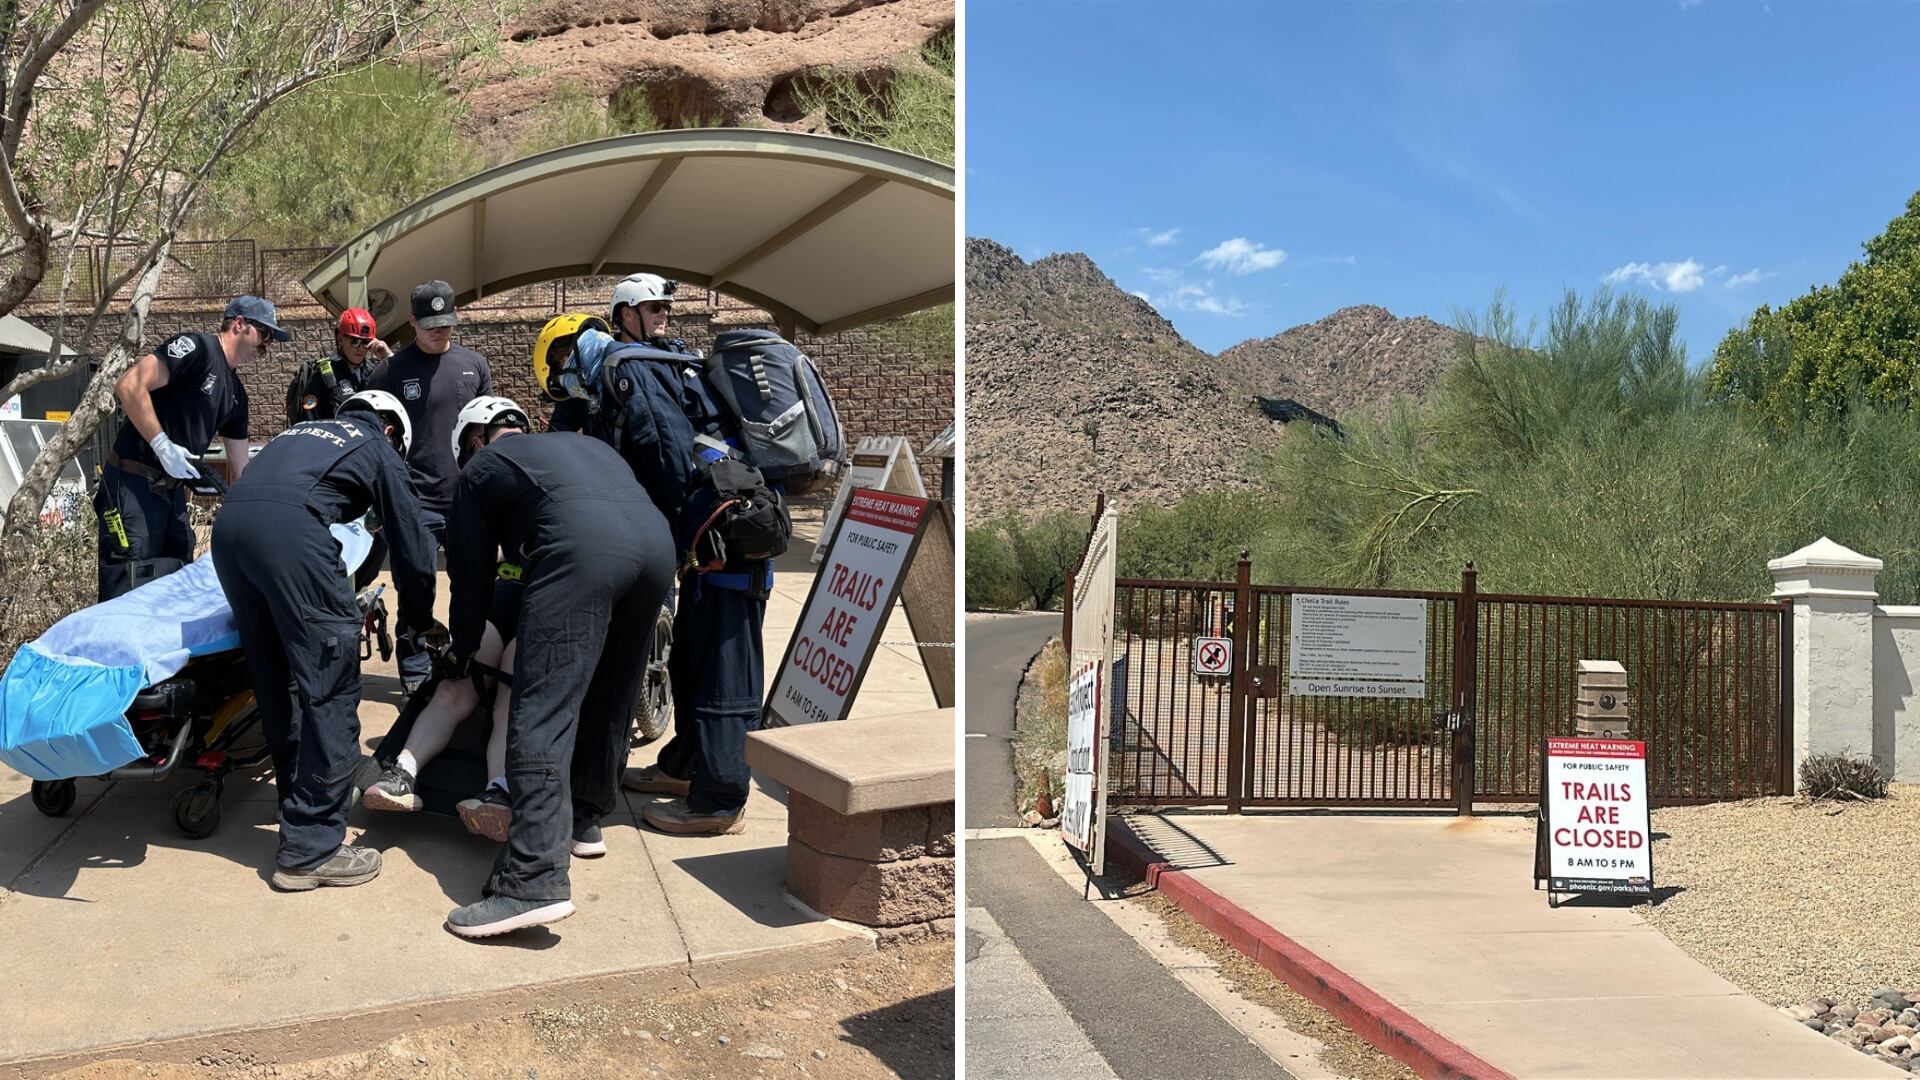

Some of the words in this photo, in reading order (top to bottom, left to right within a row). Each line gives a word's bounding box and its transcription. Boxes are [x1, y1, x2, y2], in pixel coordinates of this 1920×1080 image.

[852, 495, 875, 509] EXTREME
[873, 500, 890, 512] HEAT
[888, 502, 920, 518] WARNING
[847, 532, 860, 543] FOR
[858, 536, 877, 549] PUBLIC
[876, 540, 899, 555] SAFETY
[827, 563, 884, 611] TRAILS
[818, 606, 857, 648] ARE
[792, 636, 855, 697] CLOSED
[1308, 683, 1330, 693] Open
[1333, 684, 1364, 693] Sunrise
[1367, 685, 1376, 693] to
[1378, 686, 1406, 694] Sunset
[785, 685, 793, 699] 8
[790, 689, 804, 709] AM
[801, 699, 815, 714] TO
[811, 705, 820, 719] 5
[1549, 742, 1579, 750] EXTREME
[1600, 743, 1636, 751] WARNING
[1562, 782, 1632, 802] TRAILS
[1577, 806, 1619, 824] ARE
[1555, 828, 1643, 849] CLOSED
[1568, 858, 1574, 866] 8
[1596, 859, 1608, 867] TO
[1612, 860, 1617, 868] 5
[1620, 860, 1635, 868] PM
[1569, 884, 1650, 893] phoenix.gov/parks/trails
